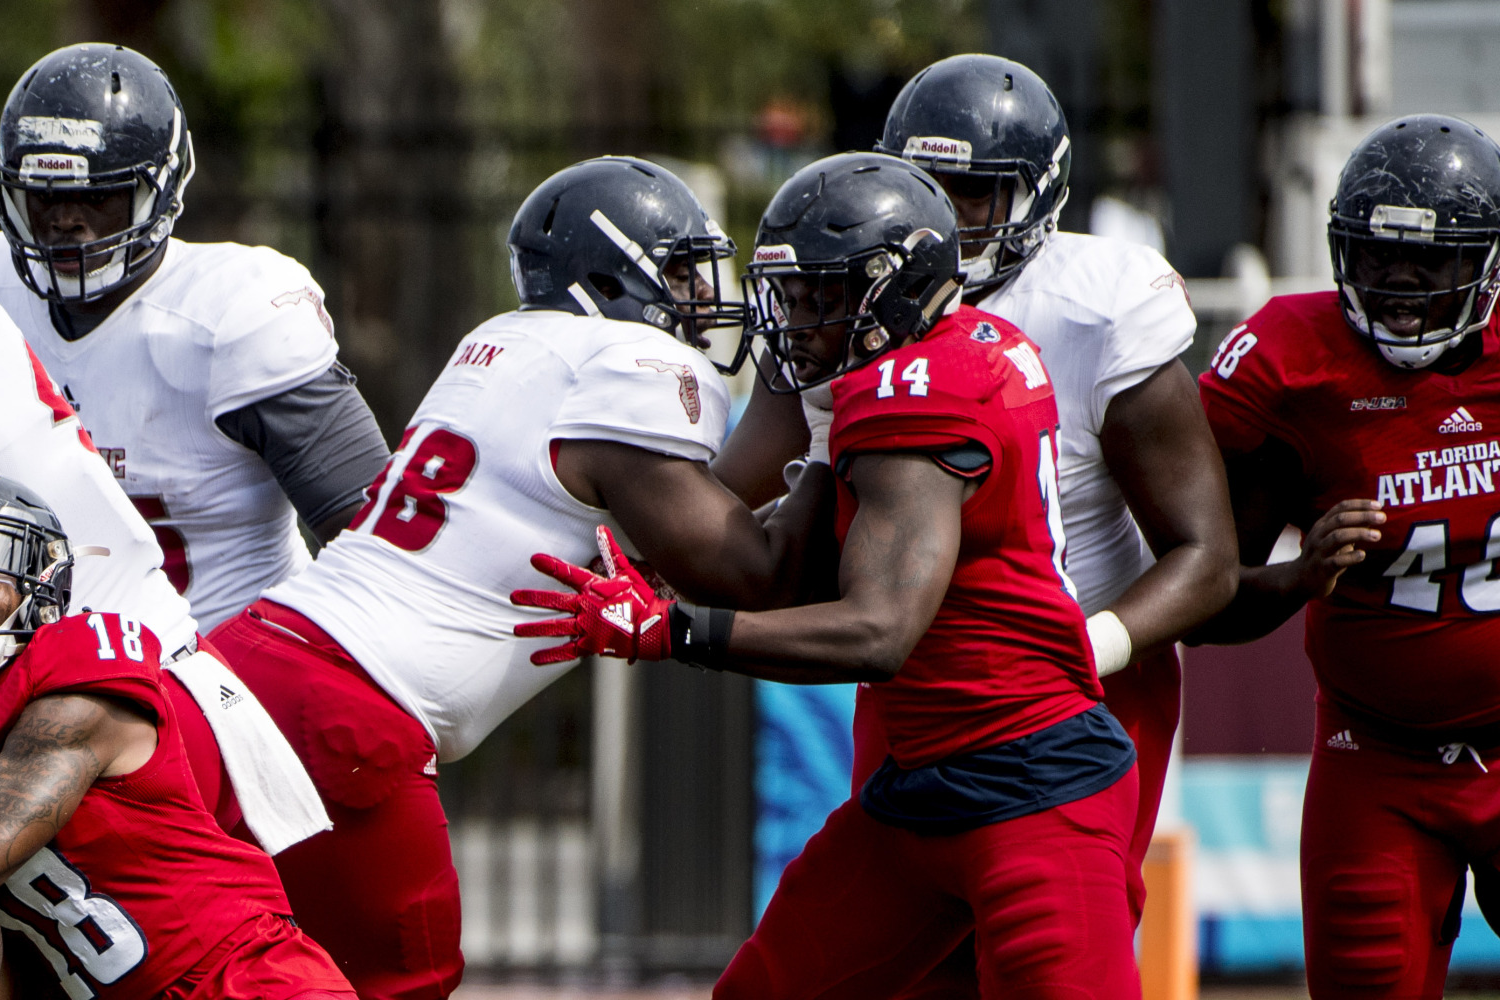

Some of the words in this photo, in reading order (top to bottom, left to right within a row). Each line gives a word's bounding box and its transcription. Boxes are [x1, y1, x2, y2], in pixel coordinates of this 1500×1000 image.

[921, 141, 958, 154] Riddell
[37, 159, 73, 170] Riddell
[756, 250, 787, 261] Riddell
[876, 357, 931, 399] 14
[682, 370, 700, 417] ATLANTIC
[1438, 421, 1483, 434] adidas
[1415, 440, 1500, 470] FLORIDA
[346, 425, 481, 556] 8
[1377, 457, 1500, 507] ATLAN
[86, 612, 145, 663] 18
[221, 694, 244, 710] adidas
[1326, 739, 1359, 751] adidas
